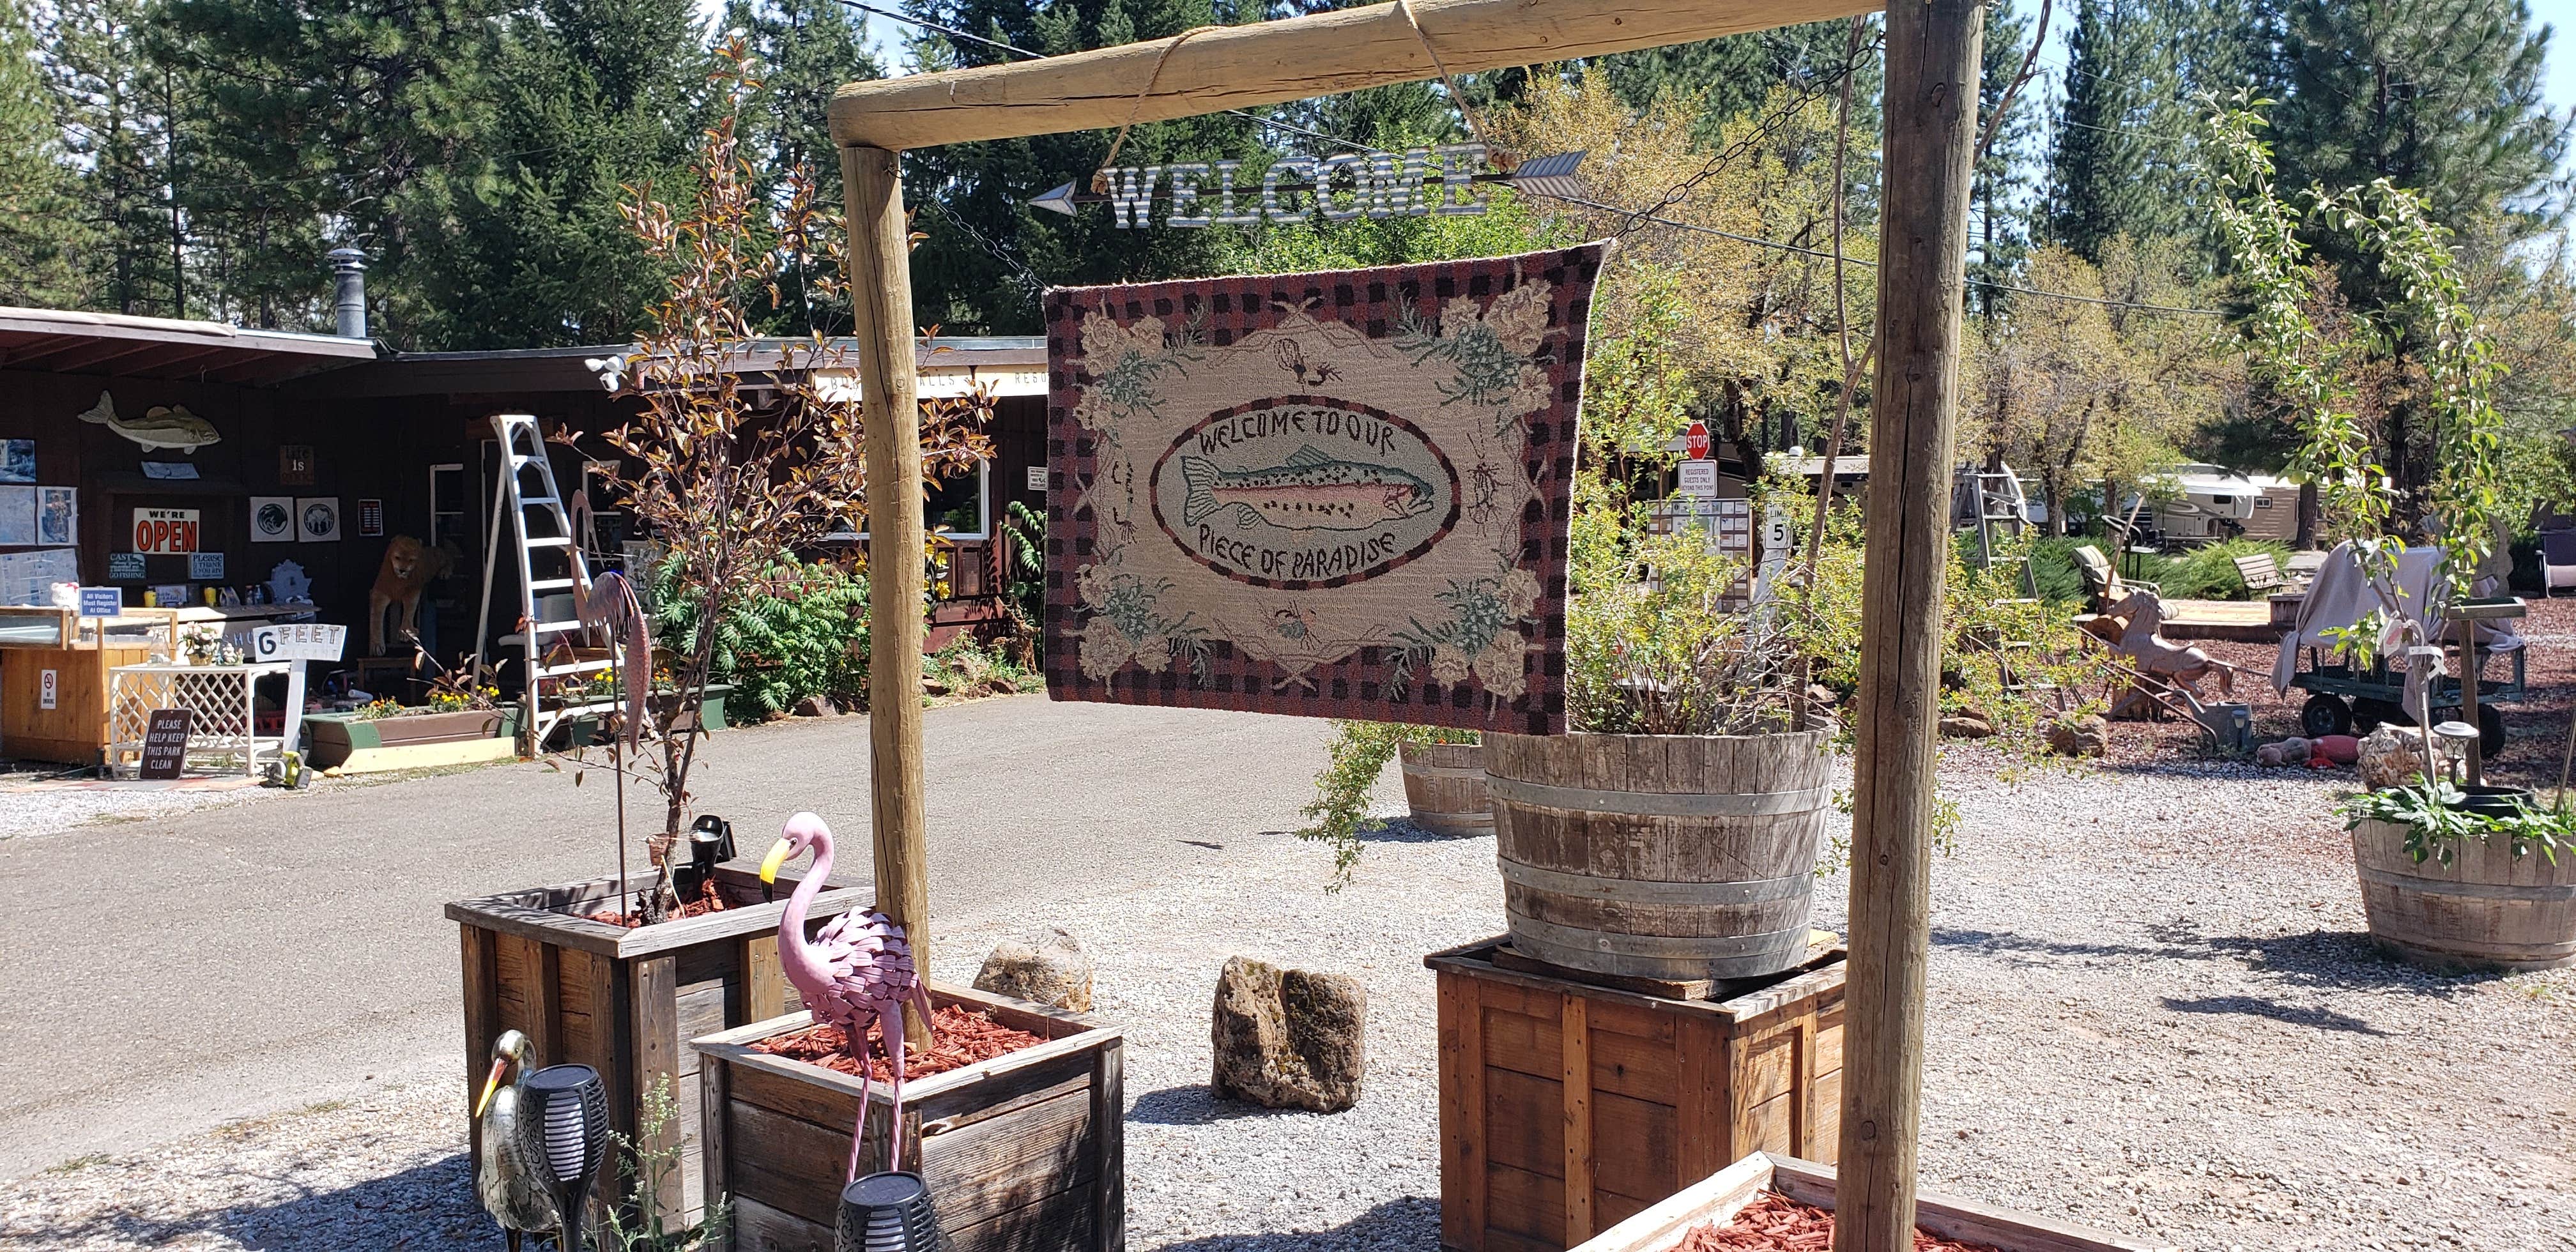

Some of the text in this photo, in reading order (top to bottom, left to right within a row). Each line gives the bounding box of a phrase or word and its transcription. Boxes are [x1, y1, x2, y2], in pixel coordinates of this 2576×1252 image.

[1104, 141, 1487, 229] WELCOME
[919, 371, 1046, 386] ALLS RESO
[1199, 410, 1395, 458] WELCOME TO OUR
[1687, 434, 1708, 448] STOP
[293, 459, 304, 471] is
[149, 510, 185, 519] WE'RE
[136, 520, 197, 553] OPEN
[1774, 524, 1784, 541] 5
[1199, 523, 1397, 579] PIECE OF PARADISE
[258, 625, 340, 655] 6 FEET
[157, 719, 182, 729] PLEASE
[149, 733, 185, 742] HELP KEEP
[147, 746, 181, 756] THIS PARK
[150, 760, 172, 769] CLEAN
